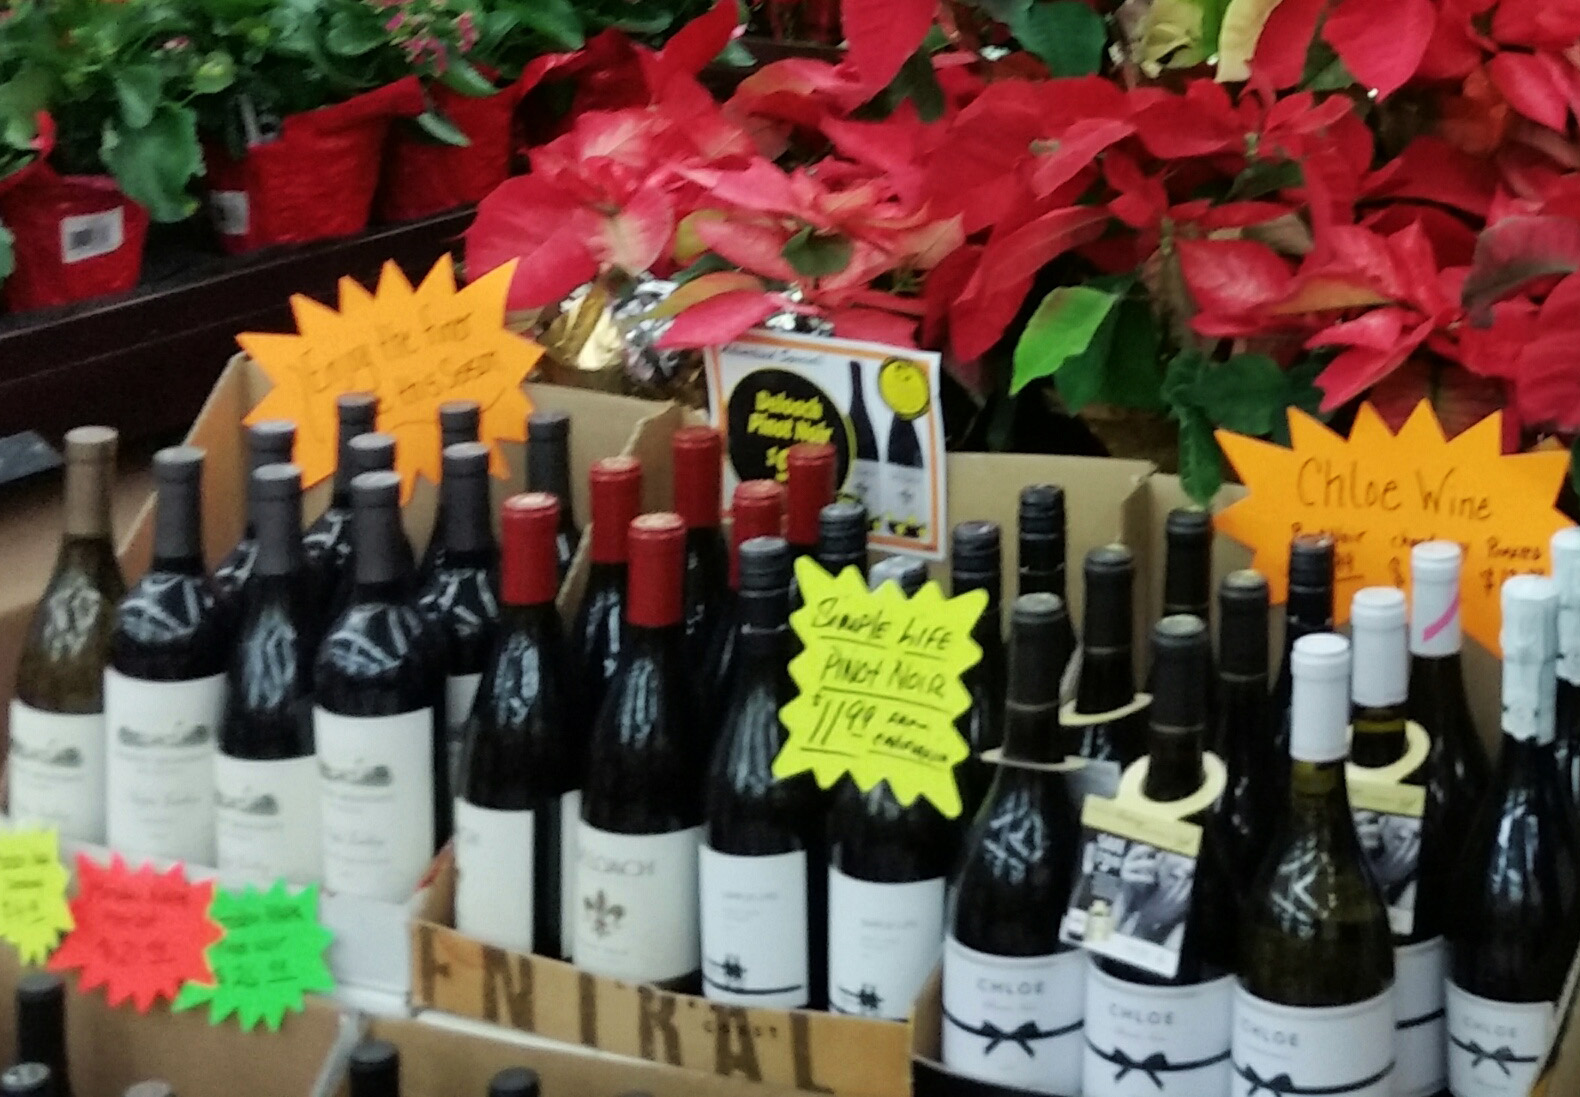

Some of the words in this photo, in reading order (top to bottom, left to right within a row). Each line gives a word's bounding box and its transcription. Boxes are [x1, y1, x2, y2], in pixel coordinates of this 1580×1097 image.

[1297, 456, 1402, 512] Chloe
[1416, 466, 1492, 522] Wine
[976, 977, 1046, 996] CHLOE
[1109, 1002, 1175, 1025] CHLOE
